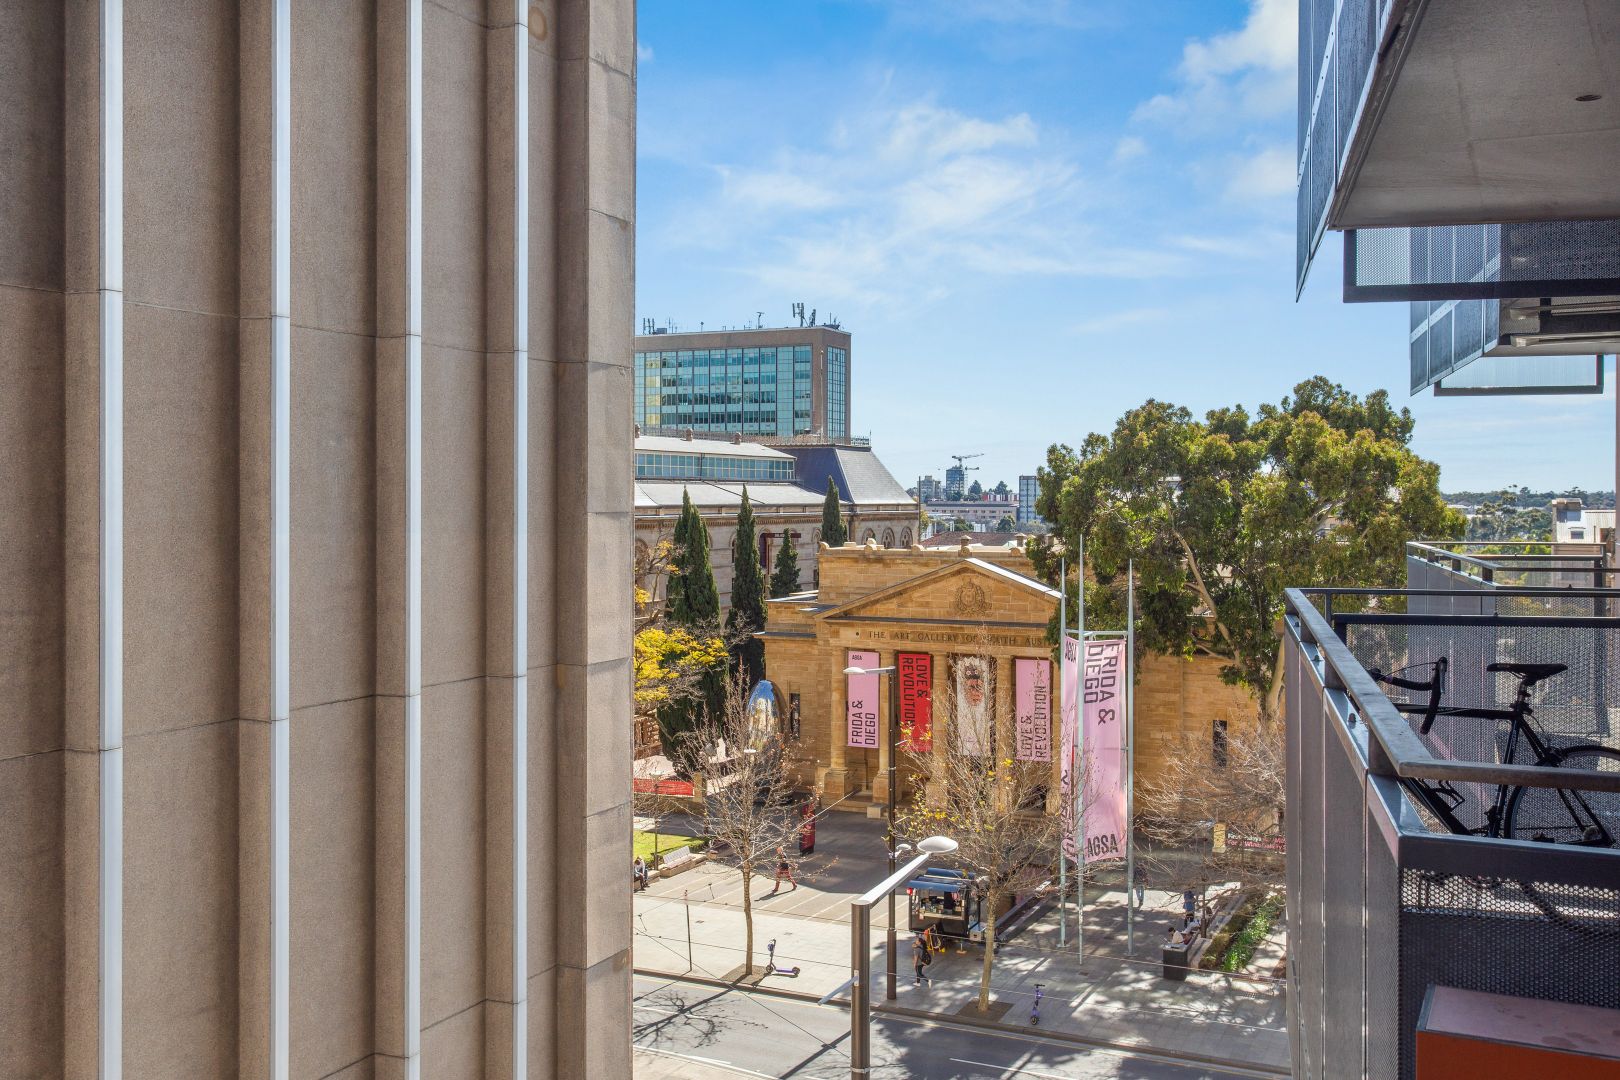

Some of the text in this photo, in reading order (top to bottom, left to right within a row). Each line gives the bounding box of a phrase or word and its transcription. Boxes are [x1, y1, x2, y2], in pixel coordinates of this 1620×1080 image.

[869, 631, 886, 639] THE
[894, 631, 911, 640] ART
[917, 632, 957, 642] GALLERY
[966, 633, 978, 643] OF
[915, 657, 928, 698] LOVE &
[1084, 644, 1104, 704] DIEGO
[1098, 643, 1120, 726] FRIDA &
[852, 700, 863, 745] FRIDA &
[865, 712, 876, 746] DIEGO
[1020, 715, 1033, 758] LOVE &
[1034, 685, 1047, 758] REVOLUTION
[1087, 833, 1119, 858] AGSA
